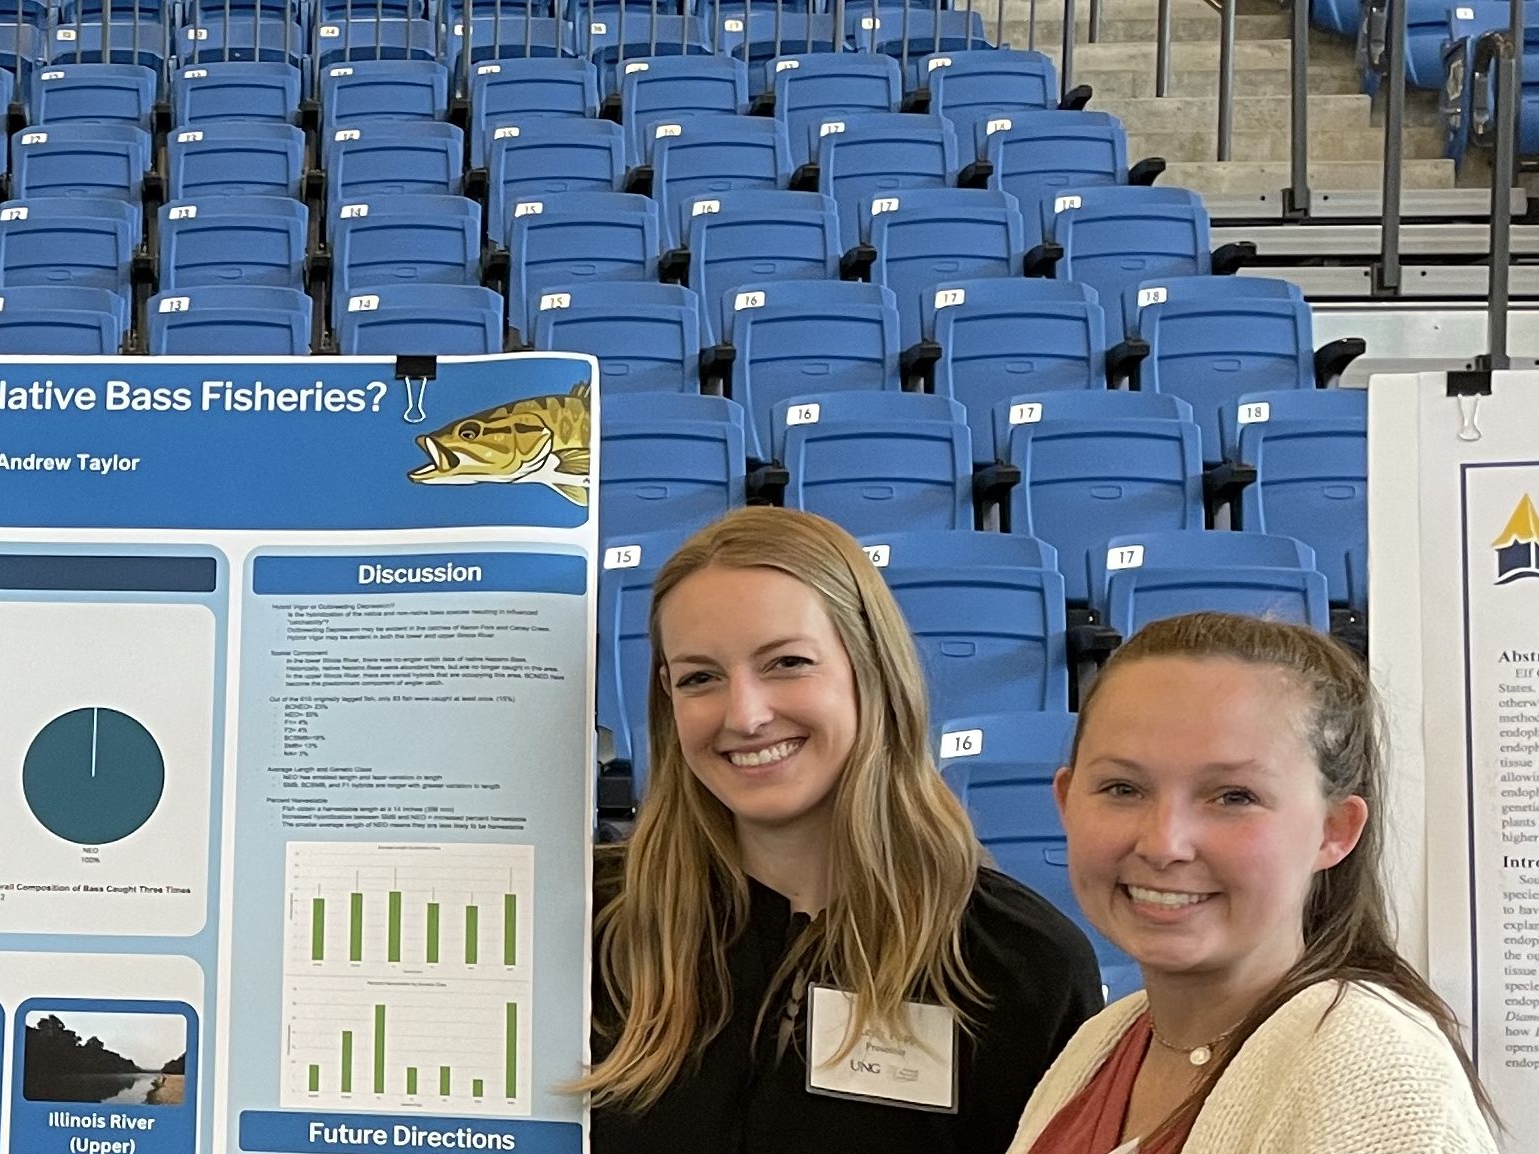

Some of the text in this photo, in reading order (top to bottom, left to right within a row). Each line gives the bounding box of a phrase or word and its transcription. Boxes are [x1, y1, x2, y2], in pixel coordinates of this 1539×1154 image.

[880, 201, 893, 212] 17
[9, 210, 21, 220] 12
[178, 208, 190, 218] 13
[744, 295, 758, 306] 16
[944, 293, 958, 304] 17
[1146, 291, 1160, 302] 18
[169, 300, 182, 312] 13
[358, 299, 371, 310] 14
[549, 297, 563, 309] 15
[106, 380, 192, 412] Bass
[202, 380, 387, 412] Fisheries?
[797, 409, 812, 420] 16
[1019, 407, 1034, 419] 17
[1247, 407, 1262, 418] 18
[77, 454, 140, 475] Taylor
[616, 550, 632, 563] 15
[1119, 550, 1135, 564] 17
[358, 562, 482, 585] Discussion
[955, 736, 973, 752] 16
[1500, 758, 1533, 768] tissue
[1502, 817, 1536, 829] plants
[1502, 832, 1539, 844] higher
[16, 883, 70, 893] Composition
[72, 884, 81, 892] of
[83, 885, 104, 893] Bass
[106, 885, 137, 895] Caught
[139, 885, 163, 893] Three
[165, 886, 191, 894] Times
[1503, 905, 1514, 915] to
[1504, 949, 1521, 960] the
[1504, 966, 1537, 976] tissue
[1506, 1027, 1529, 1037] how
[850, 1059, 881, 1074] UNG
[49, 1112, 155, 1130] Illinois River
[309, 1122, 515, 1150] Future Directions
